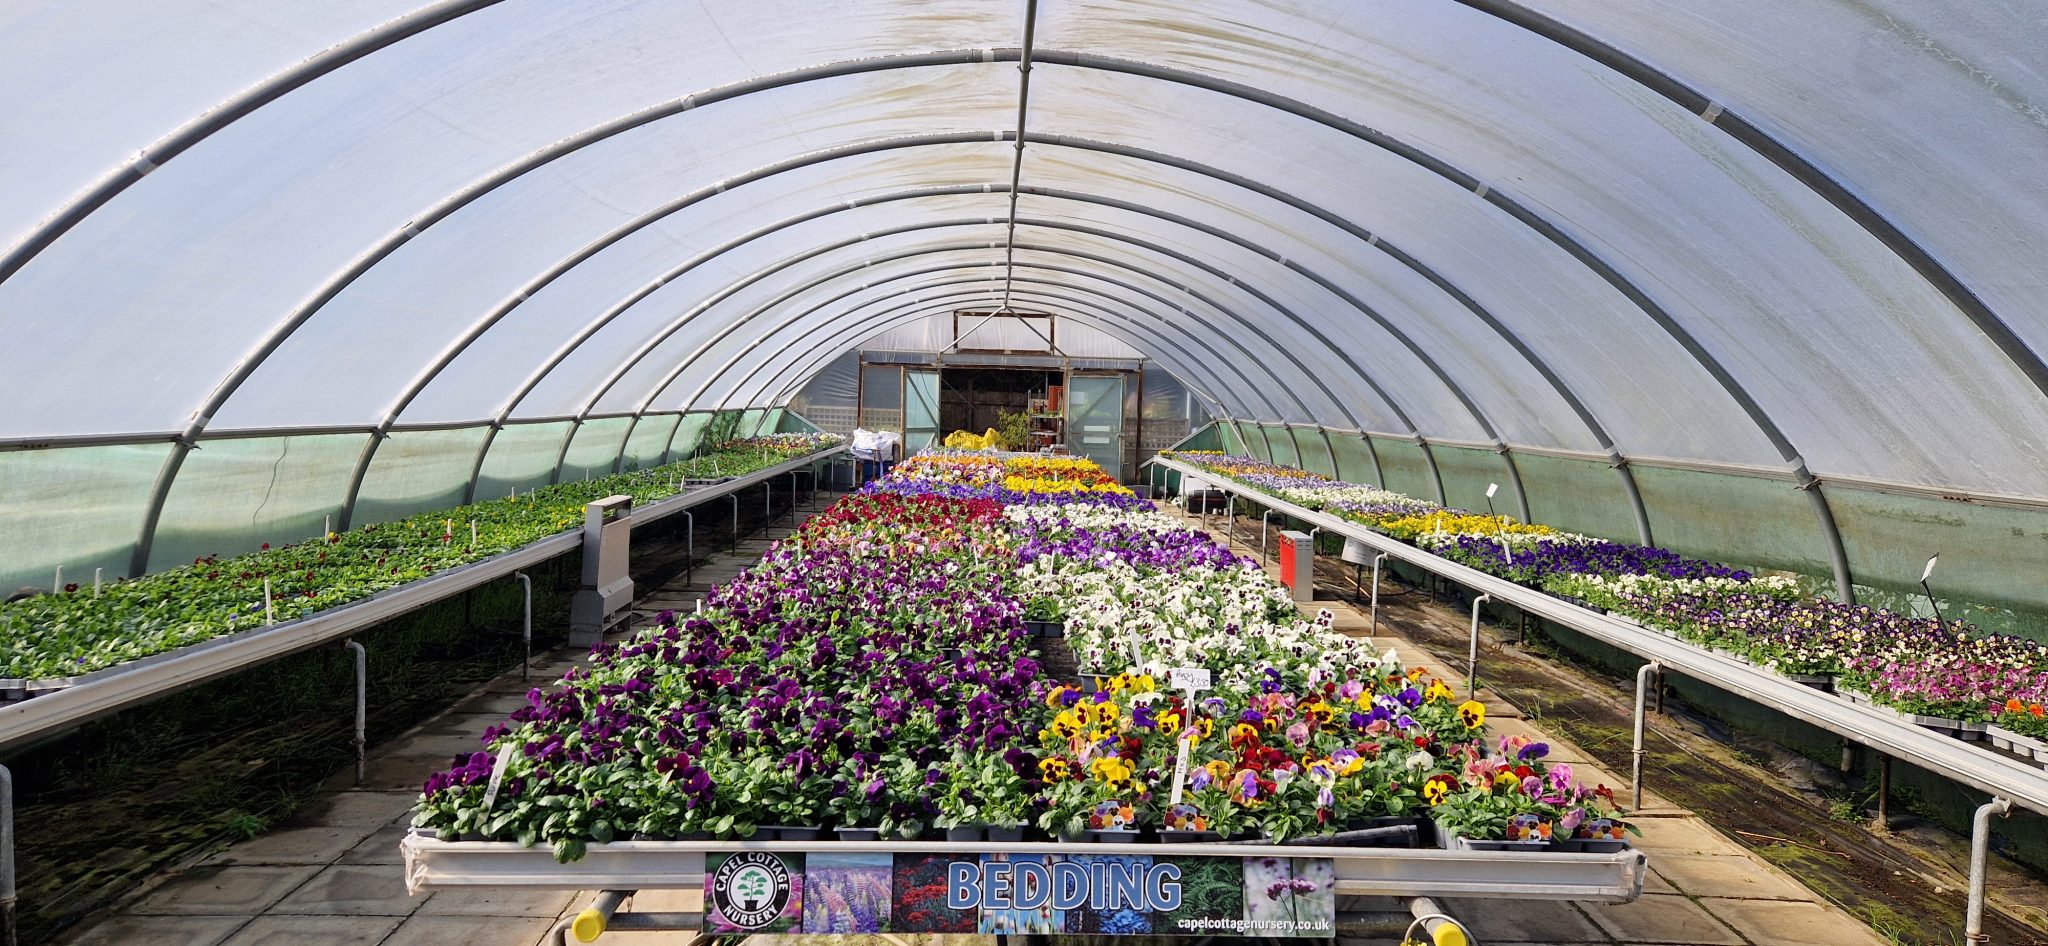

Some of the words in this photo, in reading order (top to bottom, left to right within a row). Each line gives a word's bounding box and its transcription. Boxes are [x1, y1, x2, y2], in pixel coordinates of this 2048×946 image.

[715, 856, 744, 892] CAPEL
[747, 852, 789, 891] COTTAGE
[947, 861, 1182, 912] BEDDING
[723, 904, 779, 926] NURSERY
[1178, 916, 1331, 933] capelcottagenursery.co.uk
